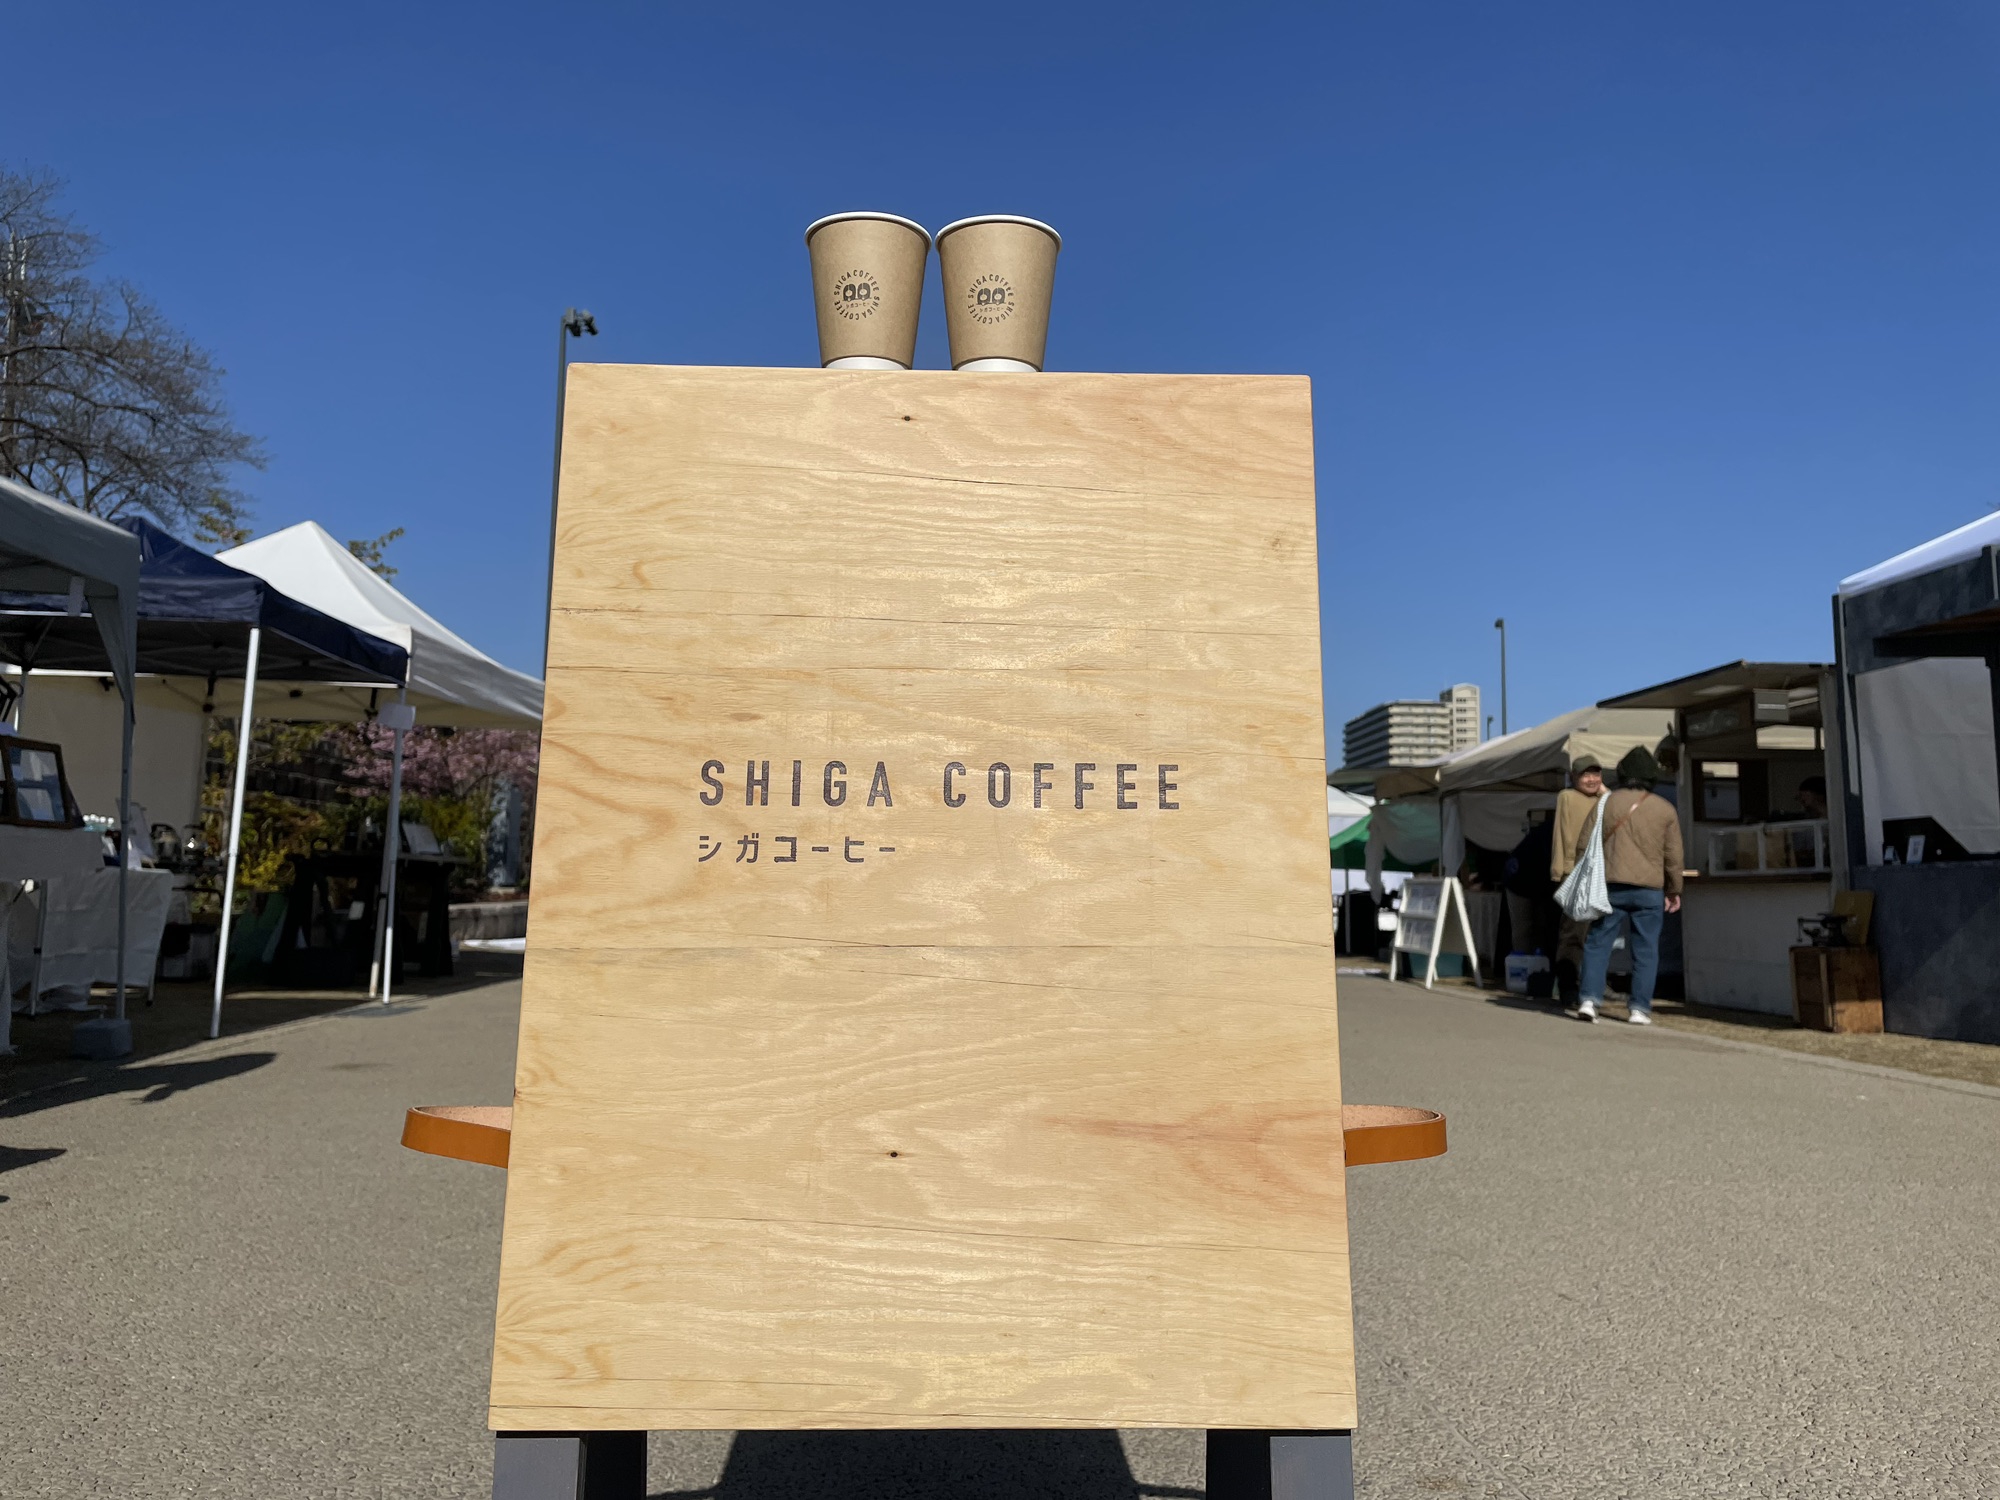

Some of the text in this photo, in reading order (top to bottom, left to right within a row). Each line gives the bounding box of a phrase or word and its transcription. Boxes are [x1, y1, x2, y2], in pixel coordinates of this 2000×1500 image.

[699, 759, 1180, 809] SHIGA COFFEE
[698, 832, 896, 863] シガコーヒー
